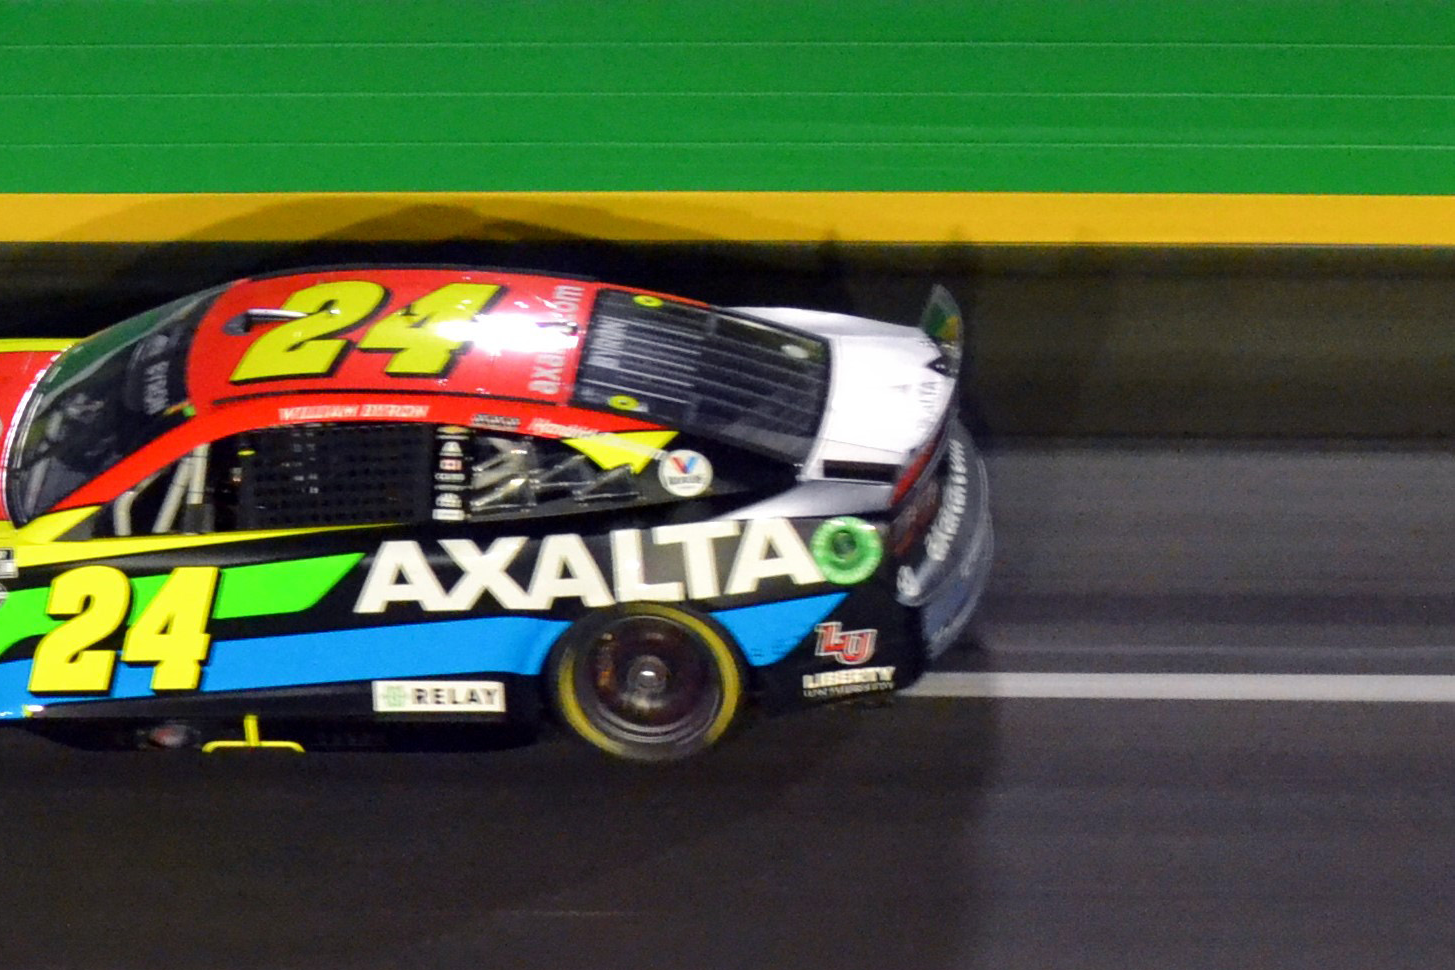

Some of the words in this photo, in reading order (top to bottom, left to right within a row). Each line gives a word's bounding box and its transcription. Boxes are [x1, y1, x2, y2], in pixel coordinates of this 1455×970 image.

[229, 280, 504, 384] 24
[353, 517, 826, 614] AXALTA
[28, 565, 220, 693] 24
[412, 687, 498, 705] RELAY
